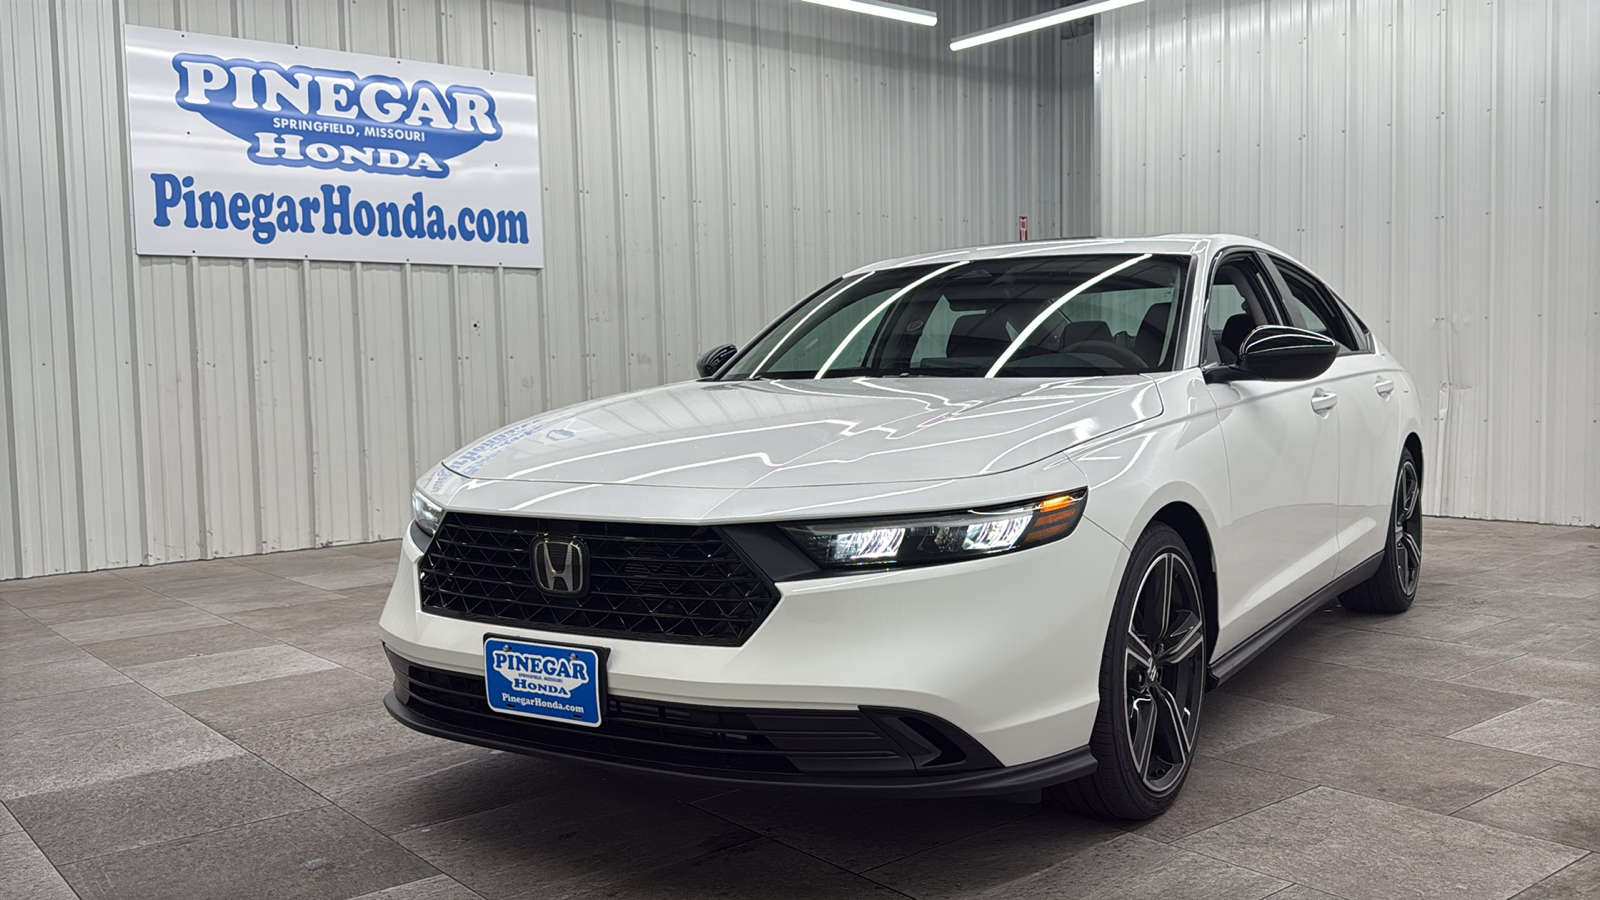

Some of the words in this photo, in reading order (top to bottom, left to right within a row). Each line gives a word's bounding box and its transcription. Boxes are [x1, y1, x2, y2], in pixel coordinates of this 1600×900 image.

[181, 61, 498, 134] PINEGAR
[273, 117, 361, 138] SPRINGFIELD,
[364, 126, 425, 142] MISSOURI
[150, 172, 529, 244] PinegarHonda.com
[494, 652, 587, 681] PINEGAR
[501, 692, 585, 714] PinegarHonda.com
